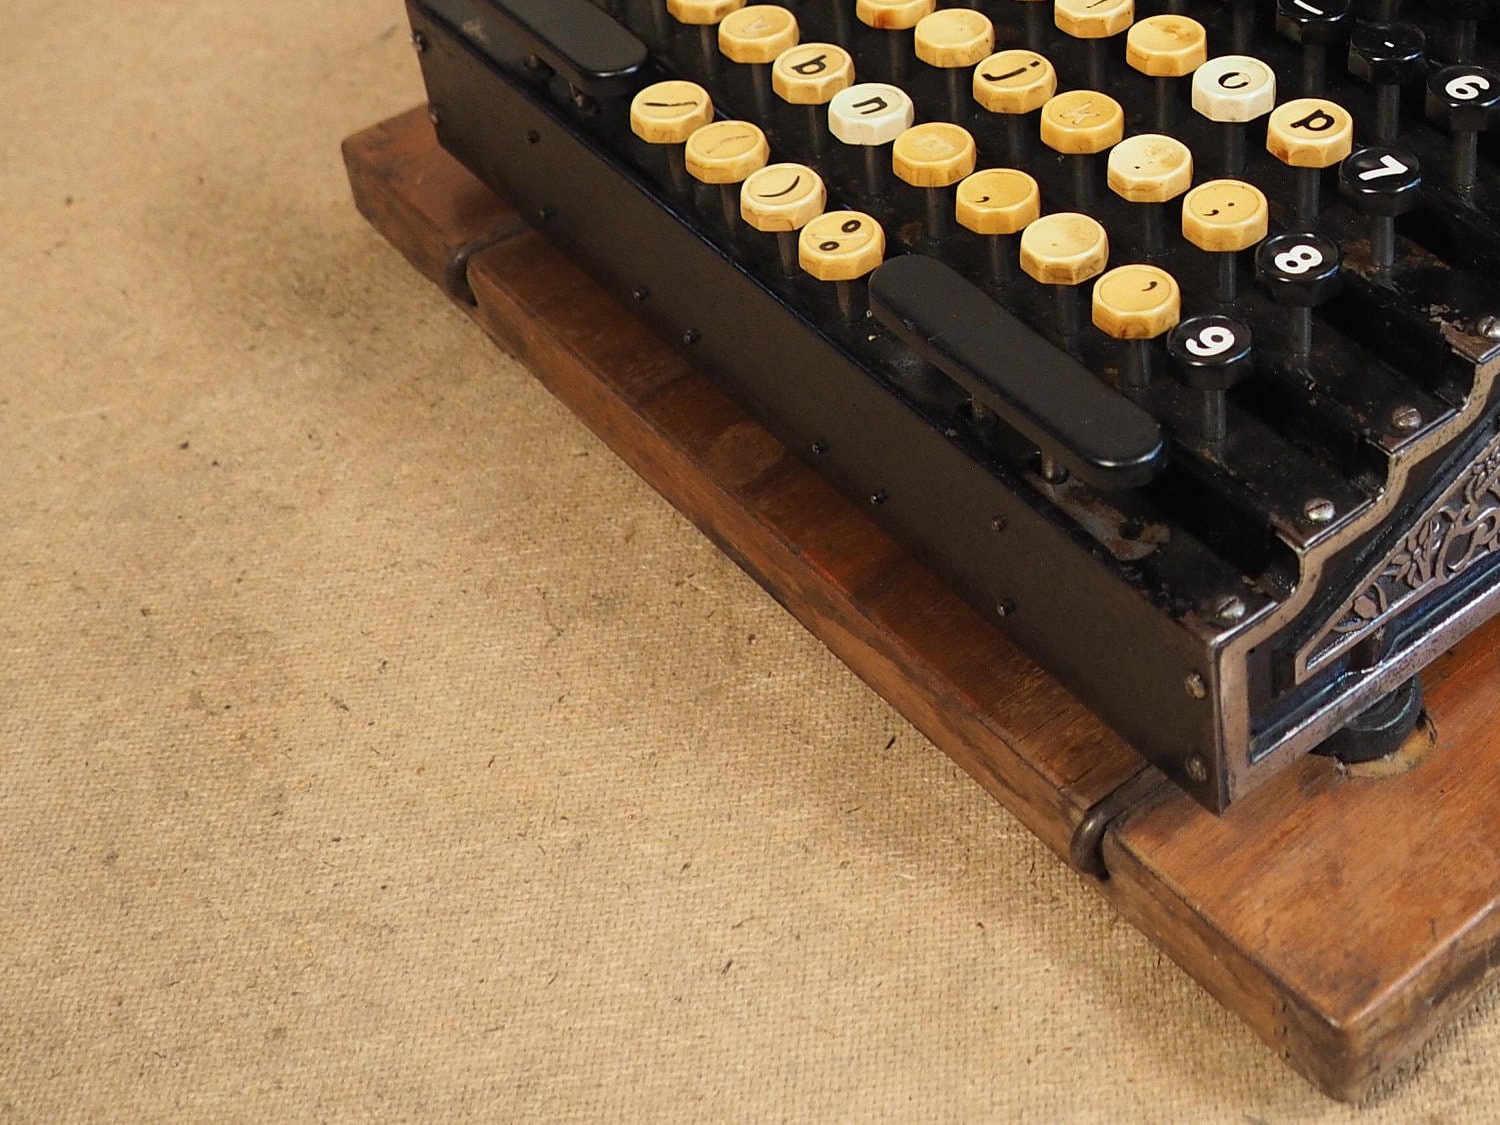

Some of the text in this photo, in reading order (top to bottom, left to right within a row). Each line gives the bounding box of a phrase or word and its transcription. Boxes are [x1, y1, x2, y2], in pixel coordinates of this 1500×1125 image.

[1445, 74, 1490, 100] 6
[1290, 108, 1335, 132] p
[1358, 154, 1409, 181] 7
[1273, 244, 1324, 274] 8
[1185, 325, 1236, 356] 9
